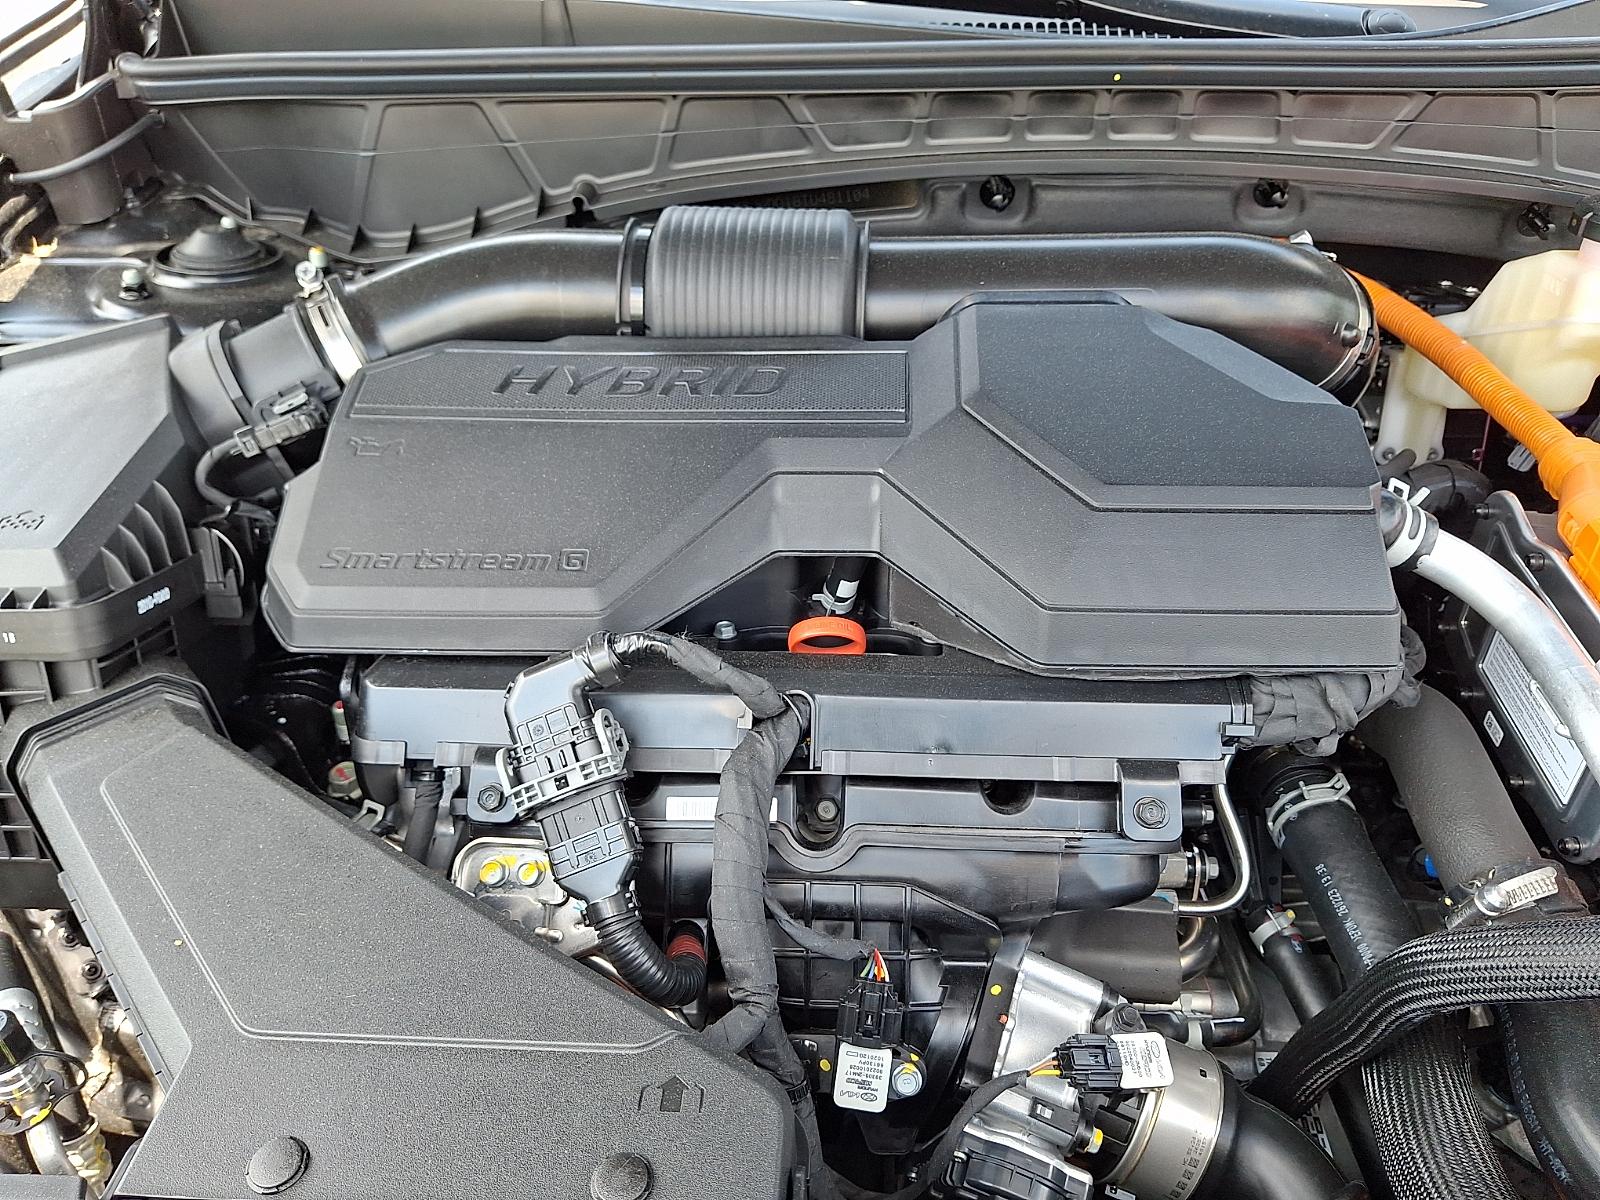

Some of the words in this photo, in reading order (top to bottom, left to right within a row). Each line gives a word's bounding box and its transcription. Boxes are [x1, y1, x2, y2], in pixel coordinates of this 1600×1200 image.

[491, 366, 787, 398] HYBRID
[319, 547, 552, 570] Smartstream
[560, 549, 588, 571] G
[1314, 863, 1333, 887] 13:38
[1327, 888, 1349, 917] 260223
